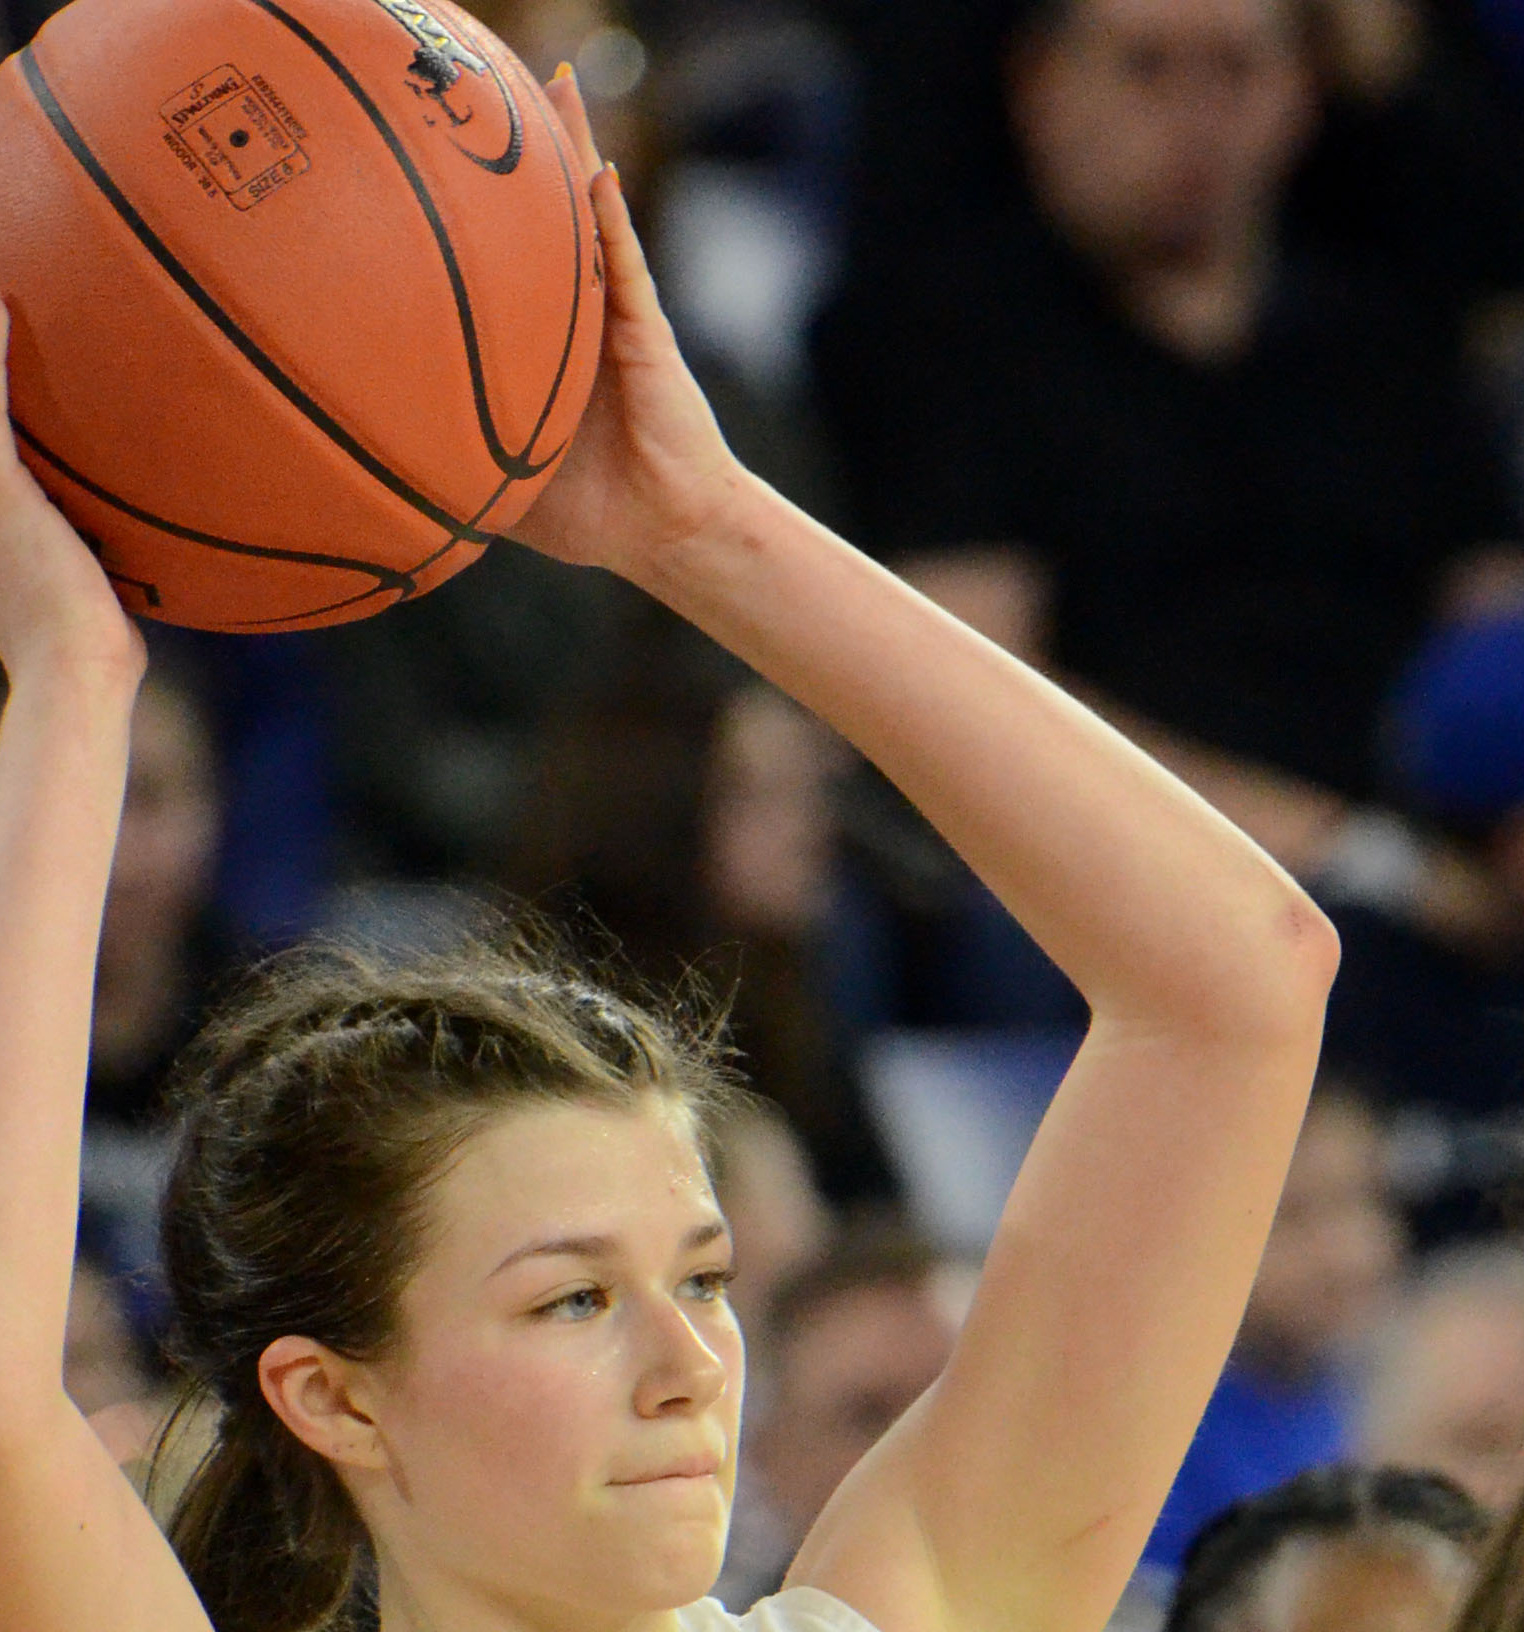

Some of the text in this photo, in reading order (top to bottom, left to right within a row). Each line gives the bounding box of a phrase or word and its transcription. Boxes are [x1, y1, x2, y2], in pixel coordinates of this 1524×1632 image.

[172, 77, 239, 128] SPALDING
[164, 134, 197, 169] INDOOR
[248, 171, 283, 198] SIZE
